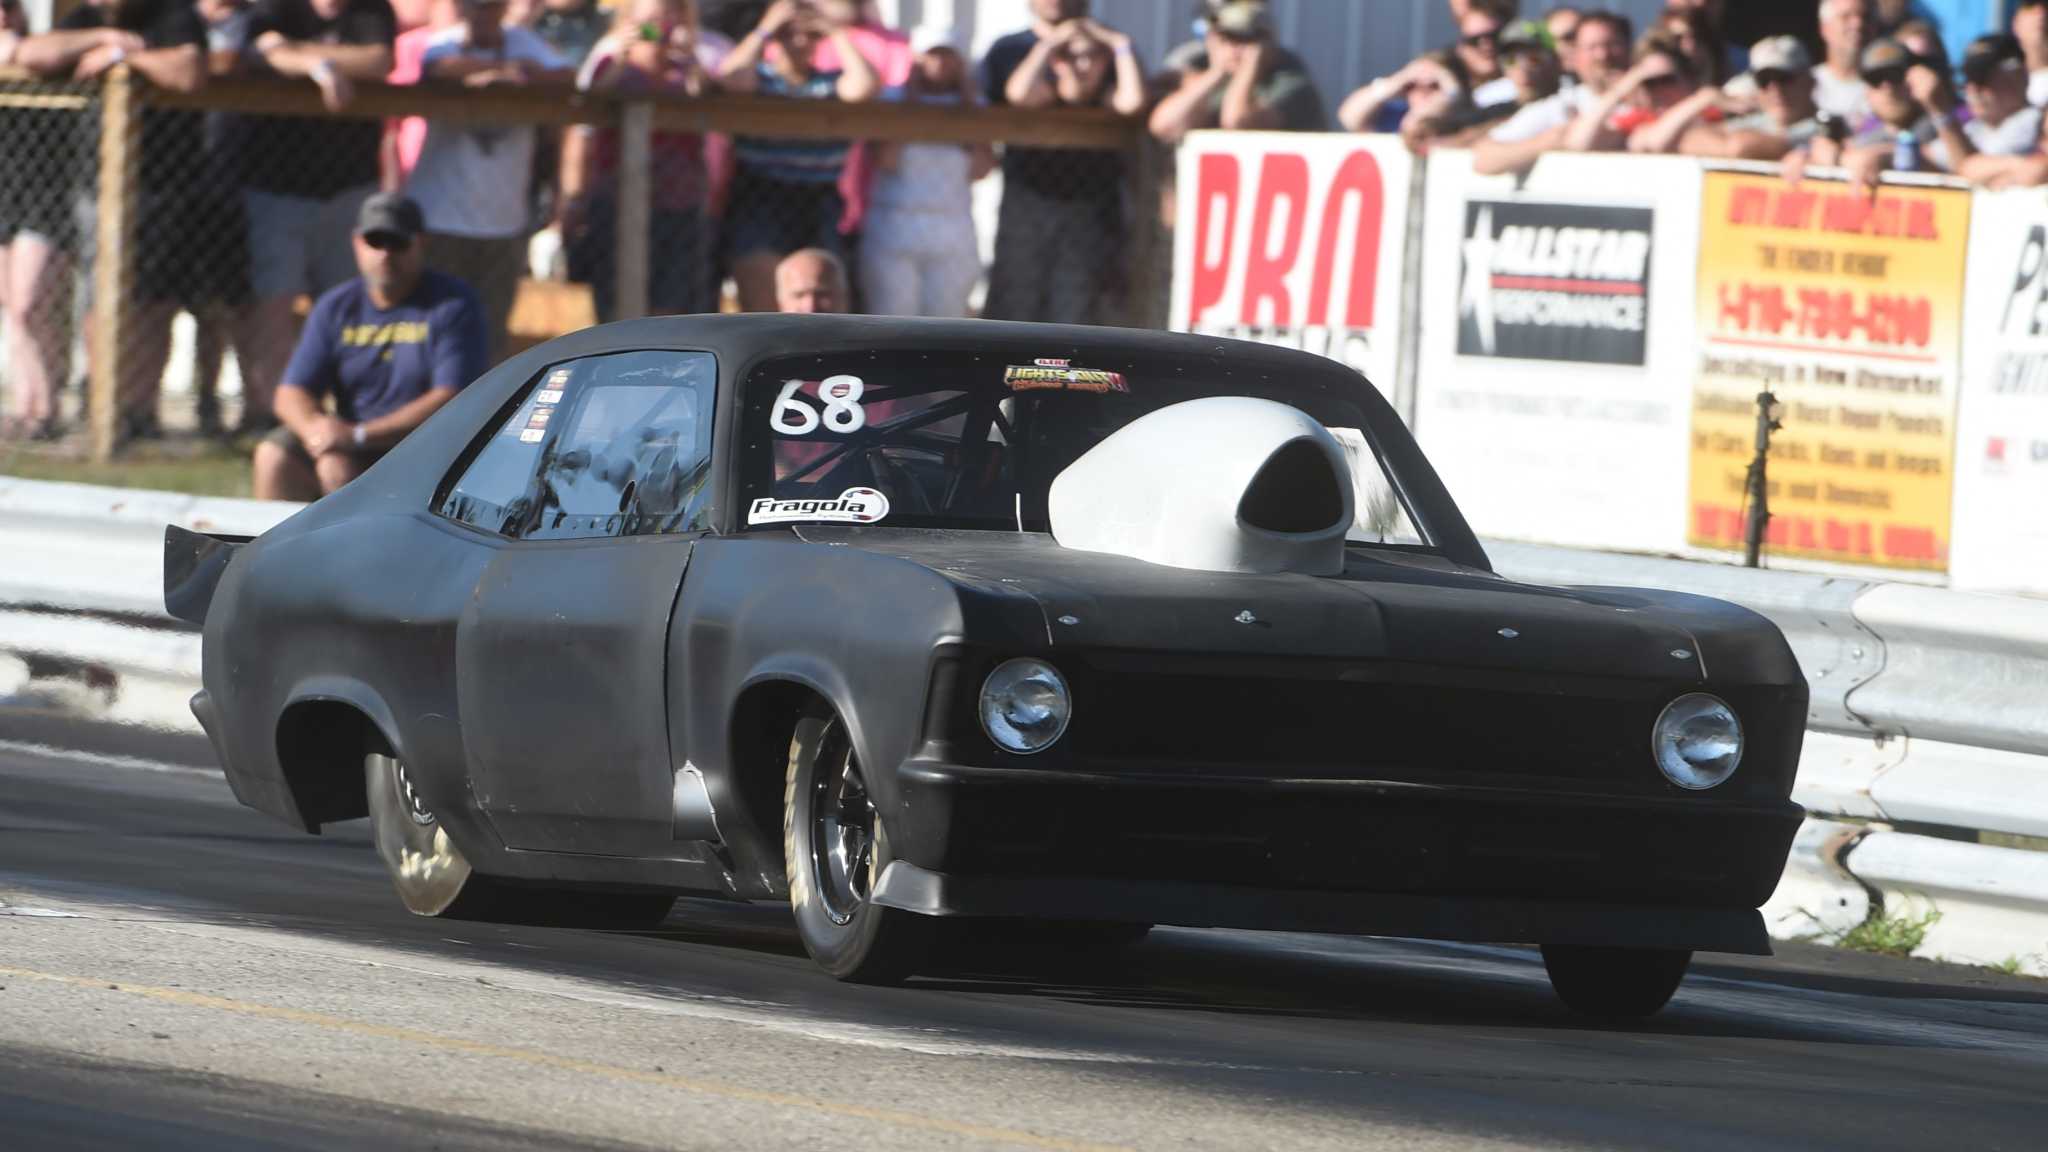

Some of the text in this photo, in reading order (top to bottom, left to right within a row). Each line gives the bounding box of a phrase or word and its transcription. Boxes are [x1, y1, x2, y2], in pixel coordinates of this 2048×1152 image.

[1188, 148, 1386, 328] PRO
[1494, 224, 1651, 280] ALLSTAR
[770, 375, 865, 435] 68
[754, 499, 866, 514] Fragola
